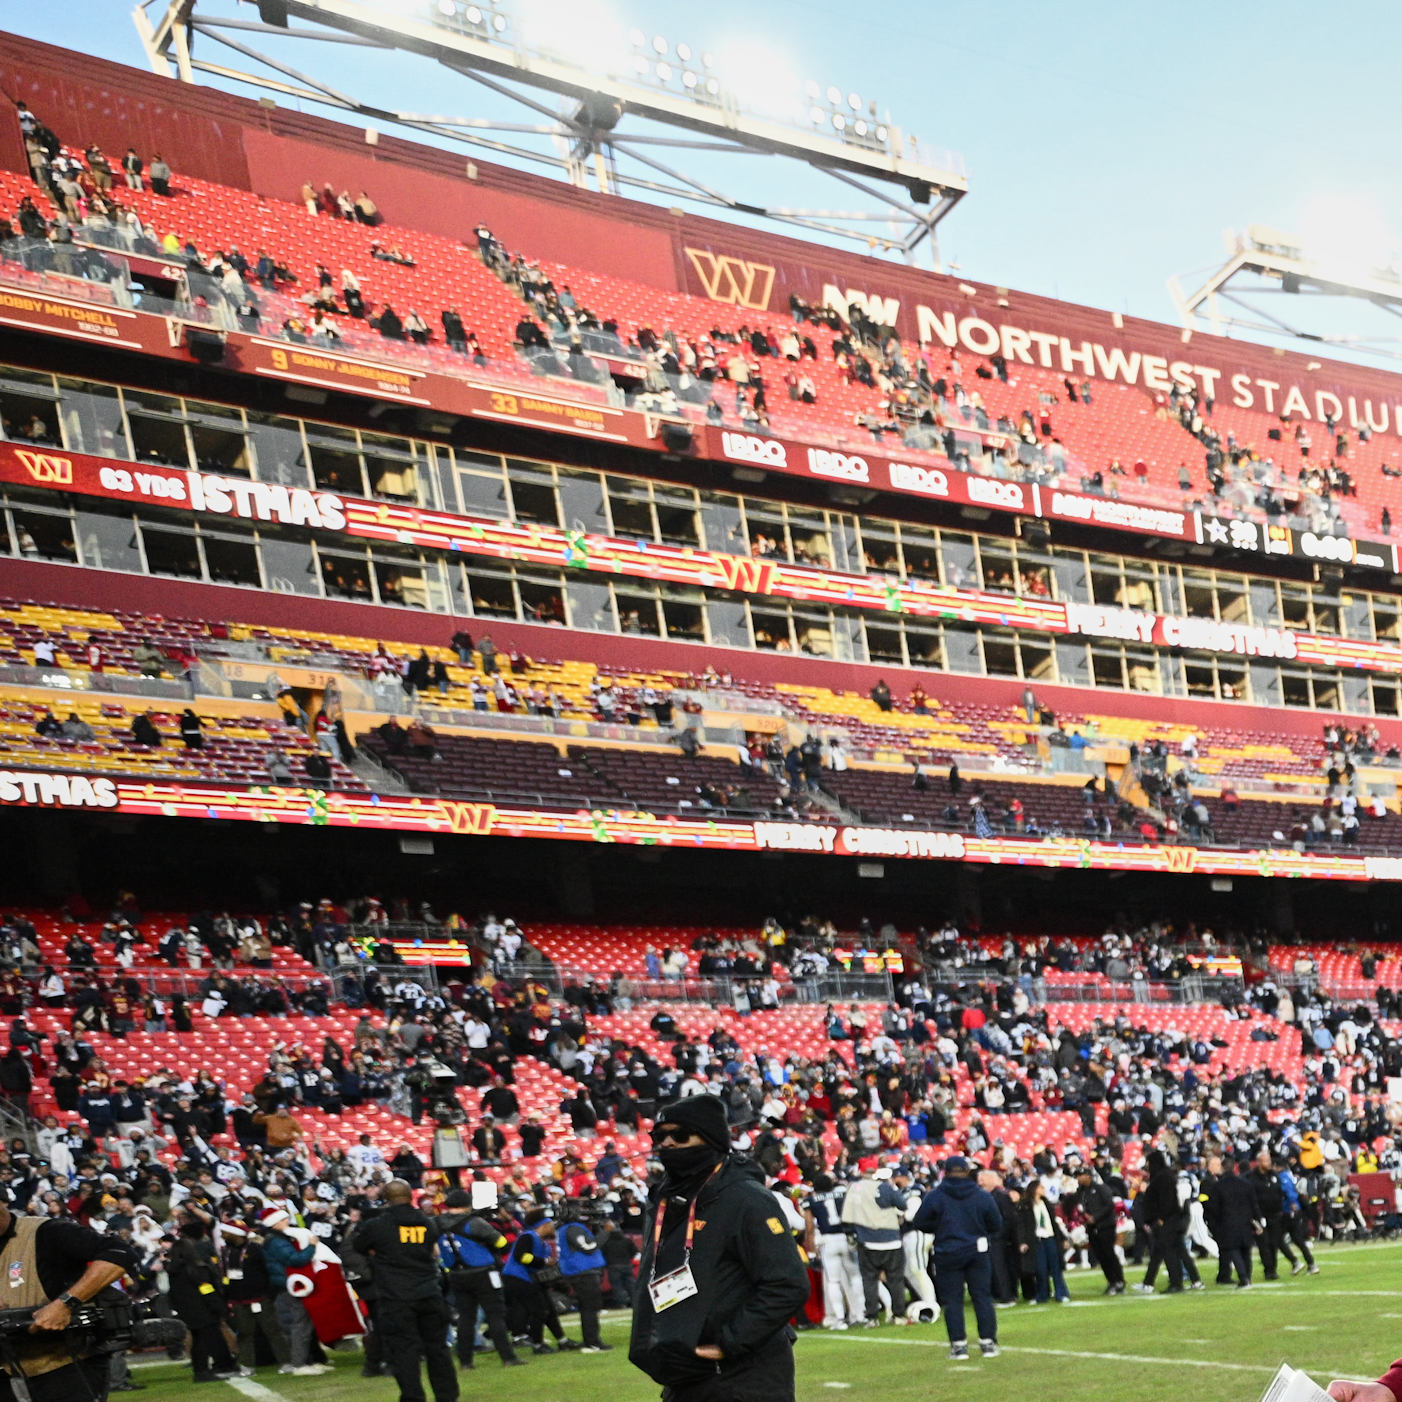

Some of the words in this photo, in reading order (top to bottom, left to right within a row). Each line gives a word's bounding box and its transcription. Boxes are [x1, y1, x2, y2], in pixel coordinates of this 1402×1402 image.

[45, 304, 117, 327] MITCHELL
[271, 349, 288, 370] 9
[917, 304, 1220, 398] NORTHWEST
[491, 393, 518, 415] 33
[138, 472, 187, 500] YDS
